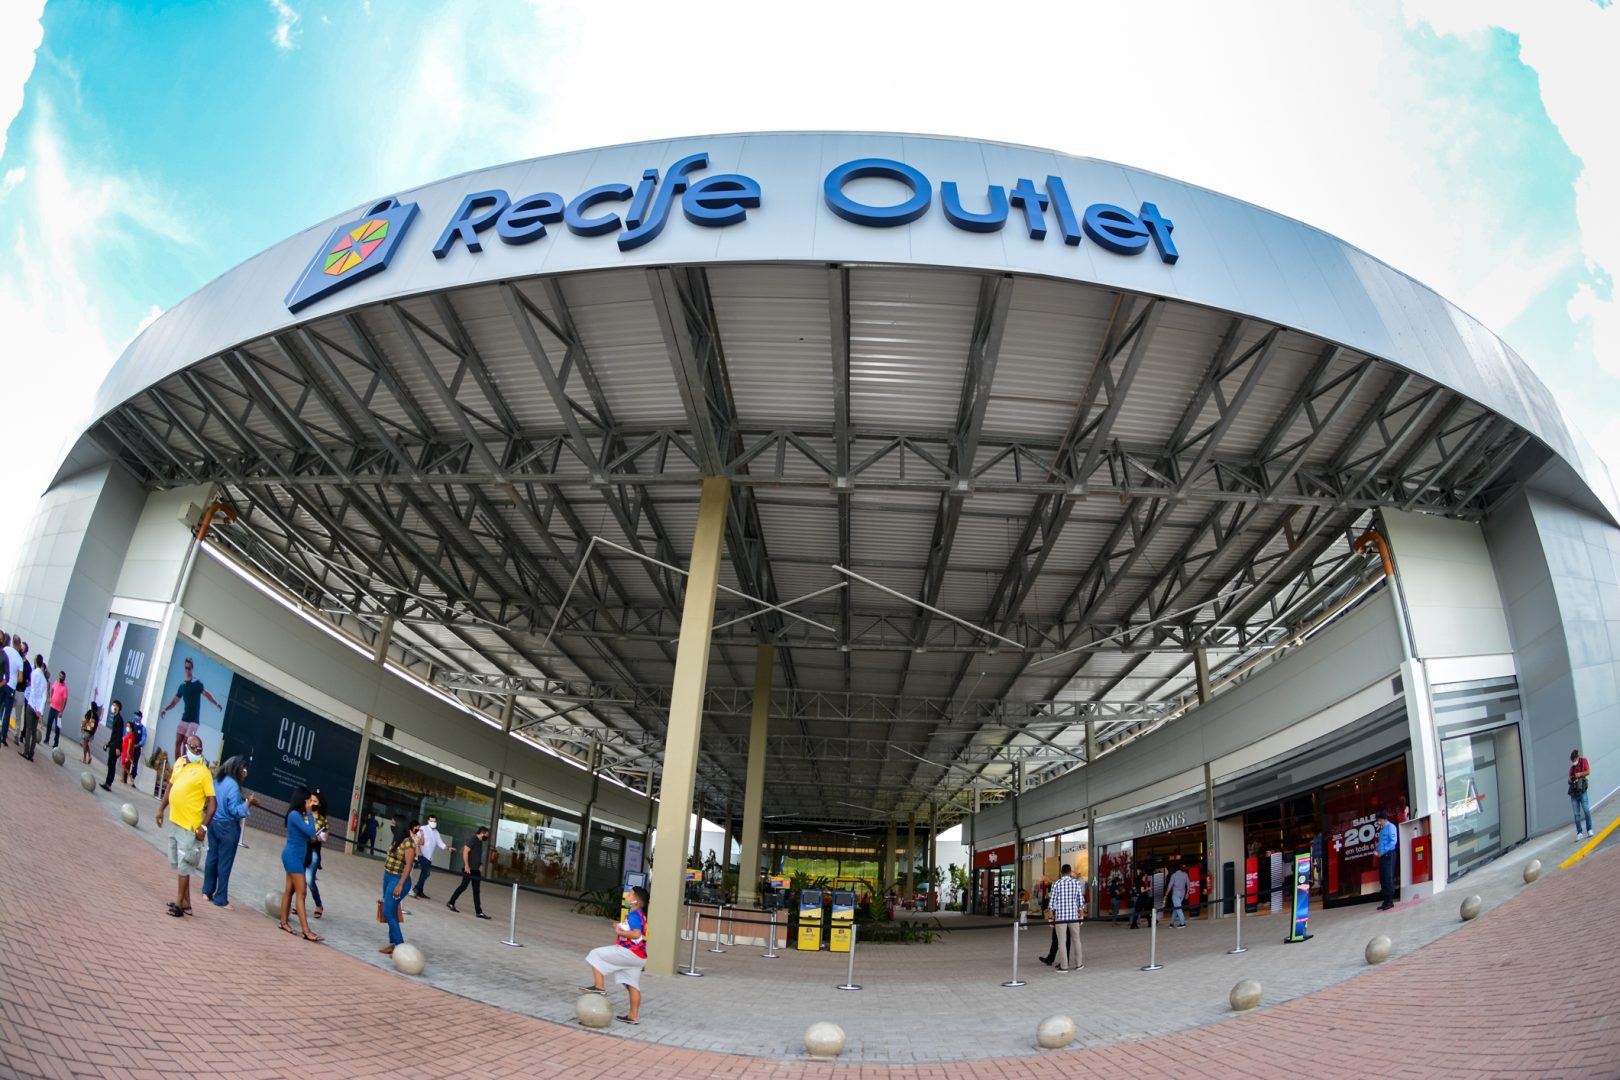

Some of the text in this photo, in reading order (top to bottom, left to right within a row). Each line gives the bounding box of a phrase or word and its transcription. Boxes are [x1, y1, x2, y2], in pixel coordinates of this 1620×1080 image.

[432, 152, 1180, 266] Recife Outlet
[282, 754, 301, 767] Outlet
[1144, 811, 1186, 835] ARAMIS
[1352, 813, 1377, 827] SALE
[1345, 848, 1355, 856] em
[1355, 844, 1370, 853] toda
